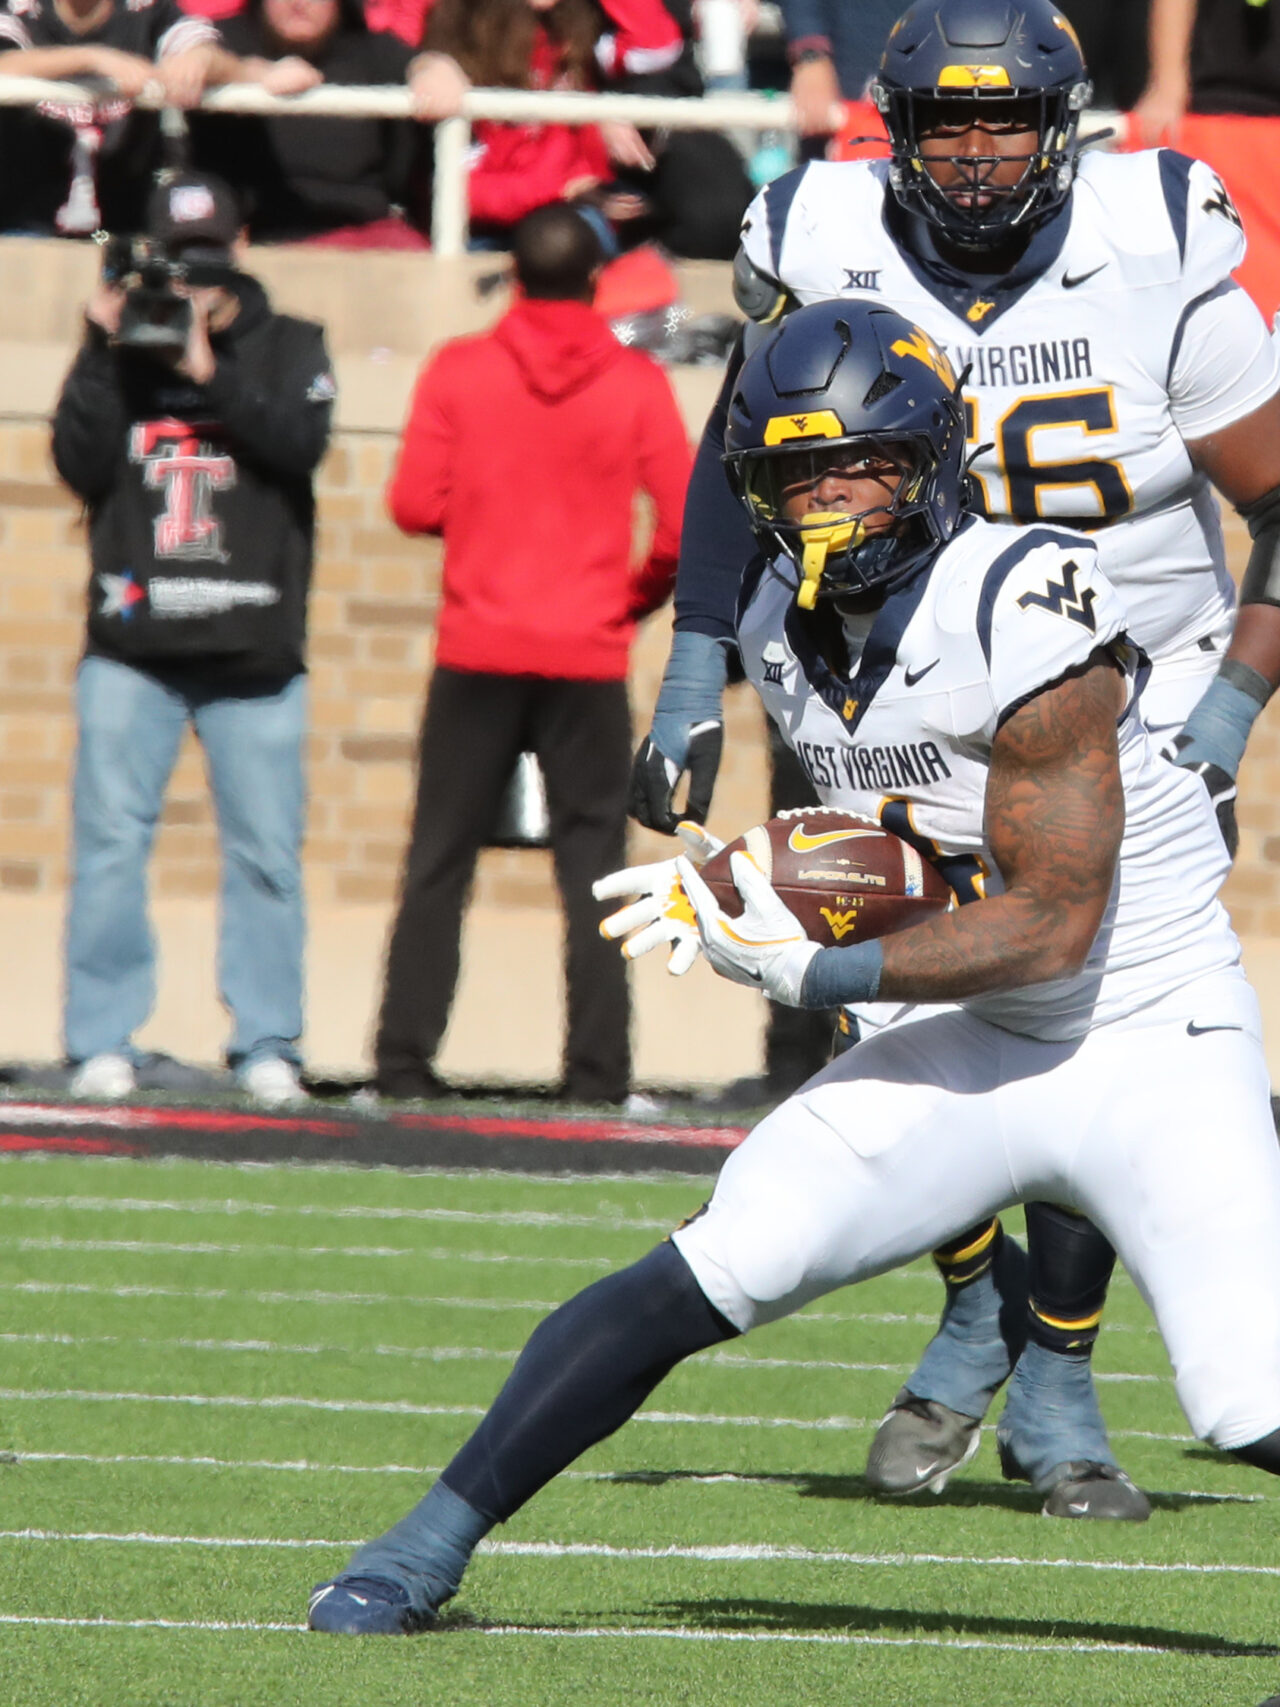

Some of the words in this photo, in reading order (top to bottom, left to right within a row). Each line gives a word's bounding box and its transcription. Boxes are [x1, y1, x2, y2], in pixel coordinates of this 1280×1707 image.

[842, 268, 882, 291] XII
[955, 337, 1092, 387] VIRGINIA
[841, 741, 953, 791] VIRGINIA
